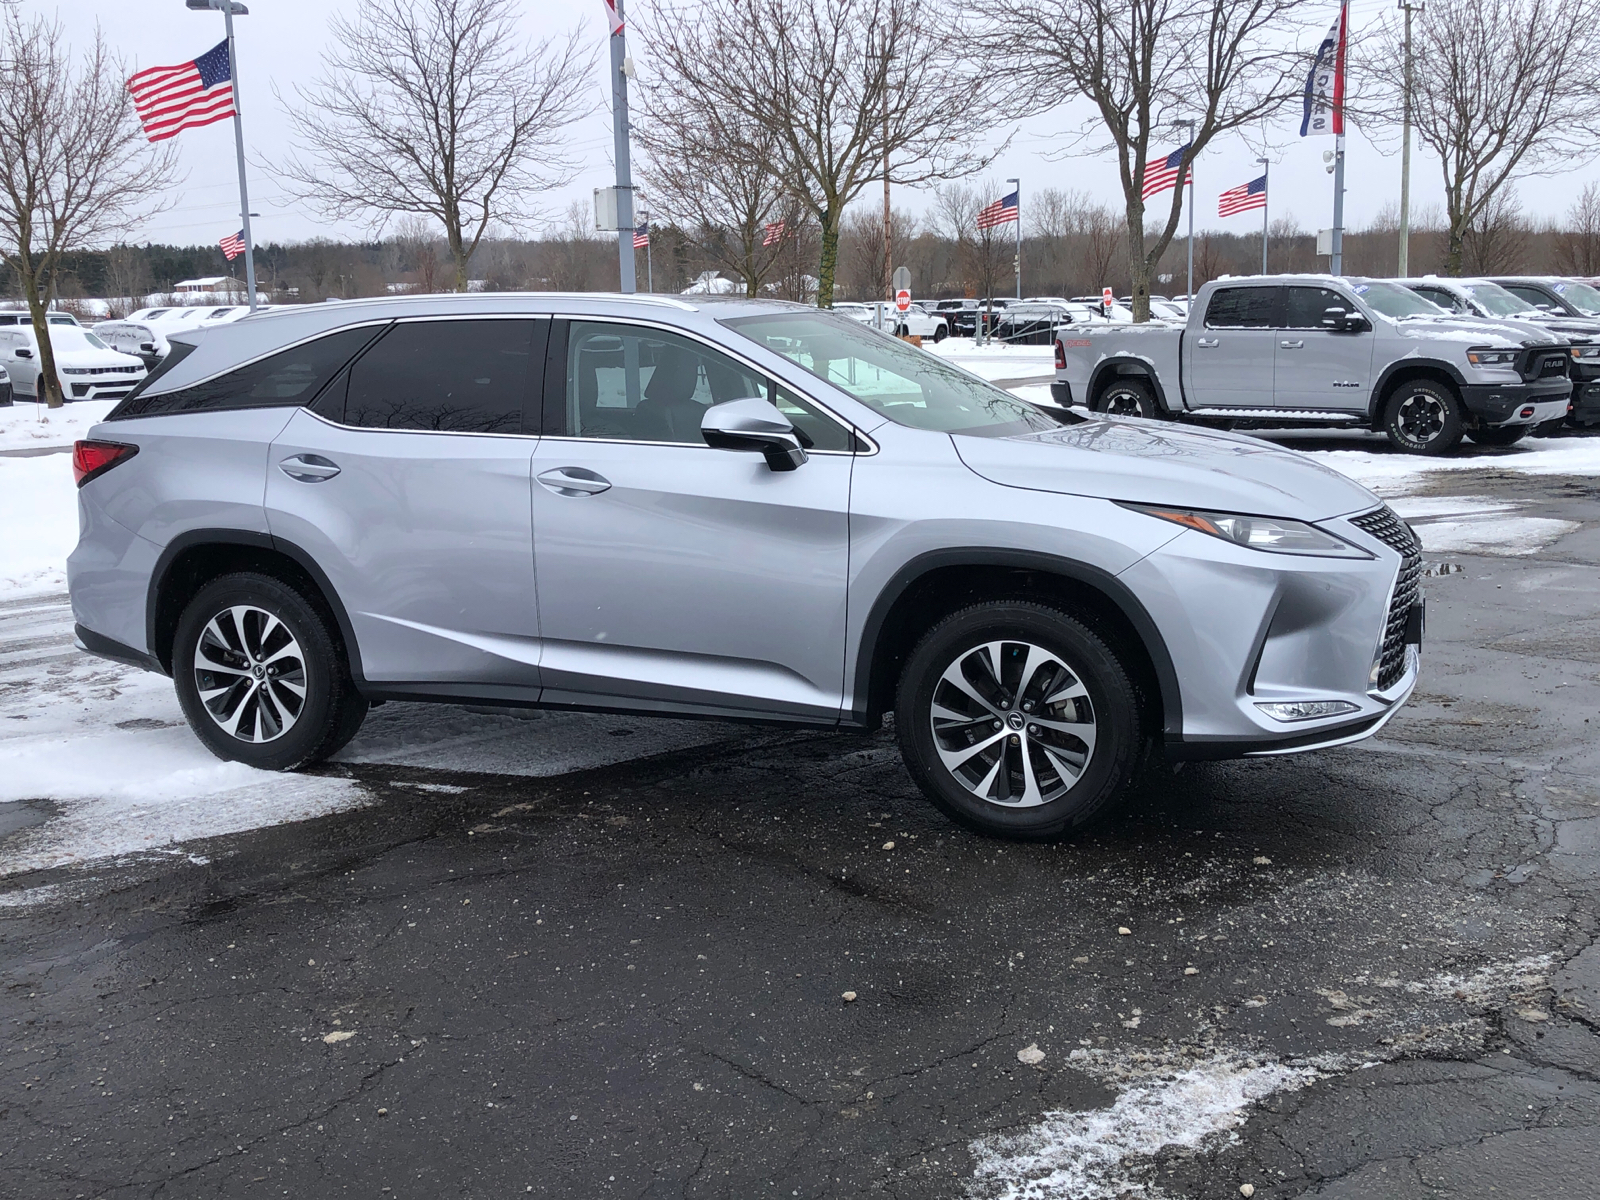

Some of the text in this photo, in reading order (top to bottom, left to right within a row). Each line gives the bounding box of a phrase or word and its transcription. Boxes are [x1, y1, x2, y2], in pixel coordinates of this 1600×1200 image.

[897, 297, 910, 306] STOP
[1065, 339, 1092, 349] REBEL
[1544, 360, 1564, 368] RAM
